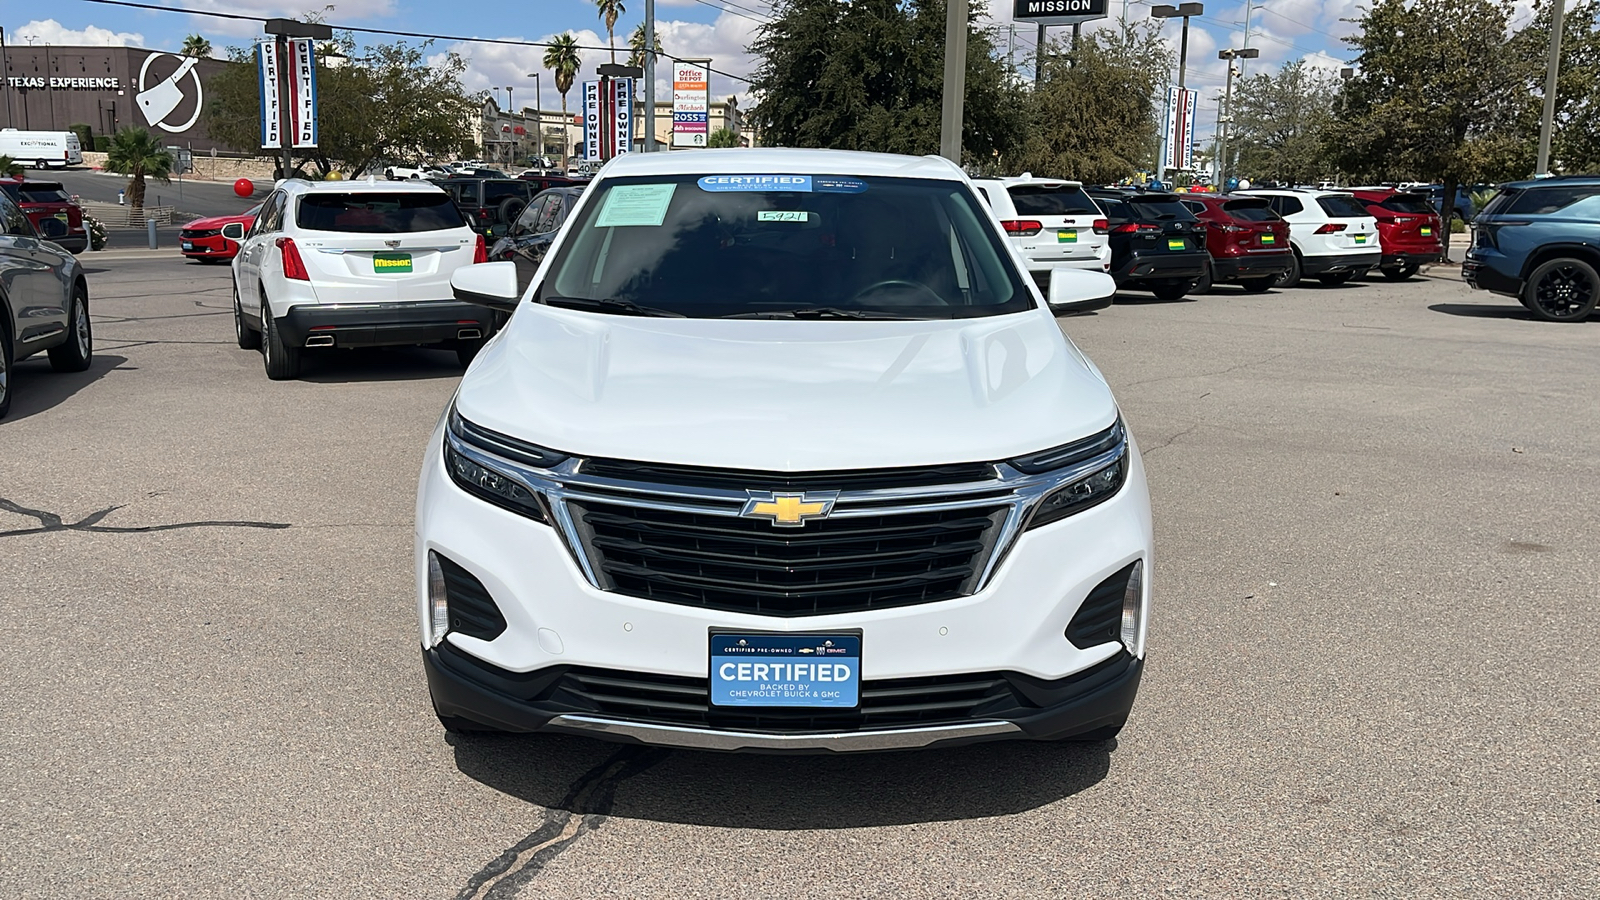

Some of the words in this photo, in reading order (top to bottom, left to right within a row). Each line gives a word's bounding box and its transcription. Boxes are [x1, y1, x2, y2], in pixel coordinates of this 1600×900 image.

[1028, 0, 1091, 12] MISSION
[679, 69, 703, 77] Office
[8, 77, 45, 87] TEXAS
[49, 77, 119, 88] EXPERIENCE
[265, 44, 277, 141] CERTIFIED
[298, 43, 312, 141] CERTIFIED
[588, 85, 597, 109] PRE
[617, 83, 627, 107] PRE
[674, 113, 699, 121] ROSS
[588, 114, 597, 157] OWNED
[578, 164, 590, 173] 40
[763, 212, 802, 221] 5921
[374, 258, 411, 267] Mission
[719, 662, 851, 682] CERTIFIED
[760, 683, 796, 691] BACKED
[729, 690, 781, 698] CHEVROLET
[784, 690, 811, 698] BUICK
